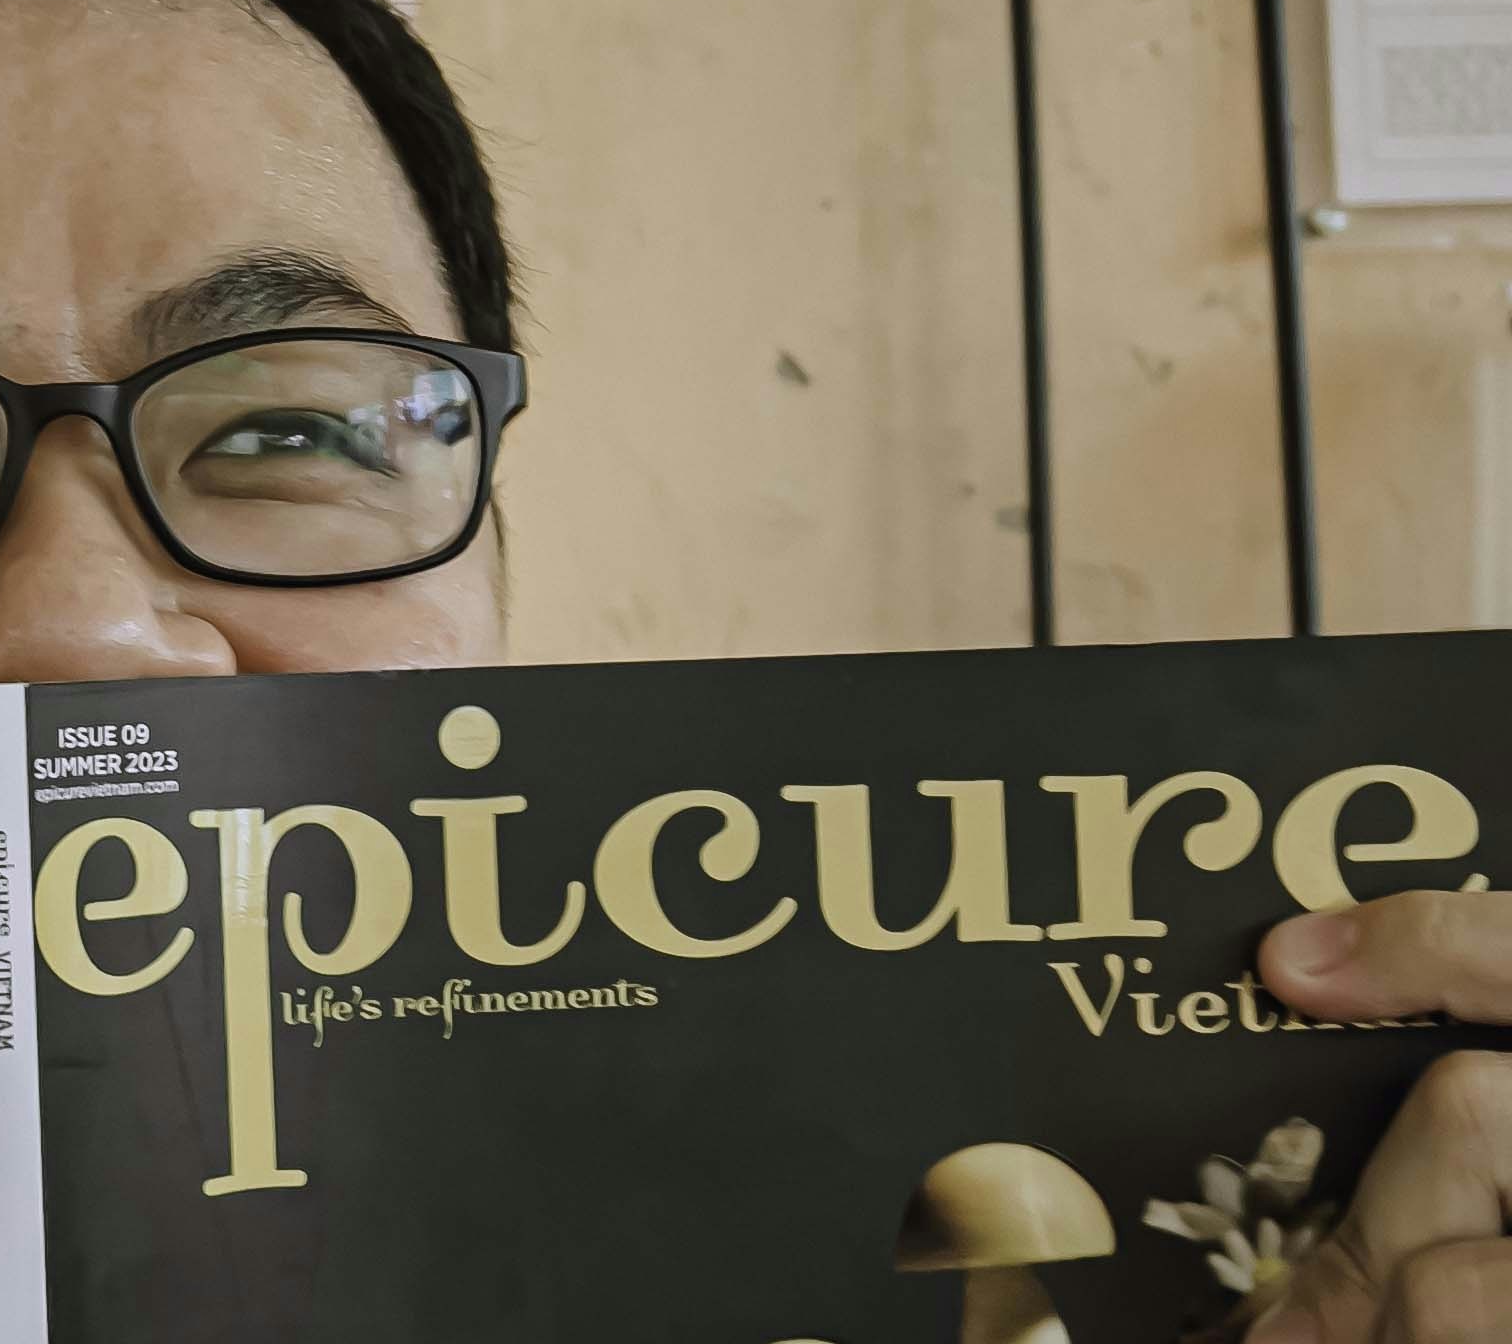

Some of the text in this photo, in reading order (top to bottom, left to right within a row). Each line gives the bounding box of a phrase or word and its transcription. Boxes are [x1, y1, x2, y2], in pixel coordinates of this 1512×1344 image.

[34, 750, 179, 779] SUMMER 2023
[58, 723, 151, 749] ISSUE 09
[34, 706, 1488, 1195] epicure
[280, 978, 659, 1048] life's refinements
[1045, 953, 1440, 1036] Viet
